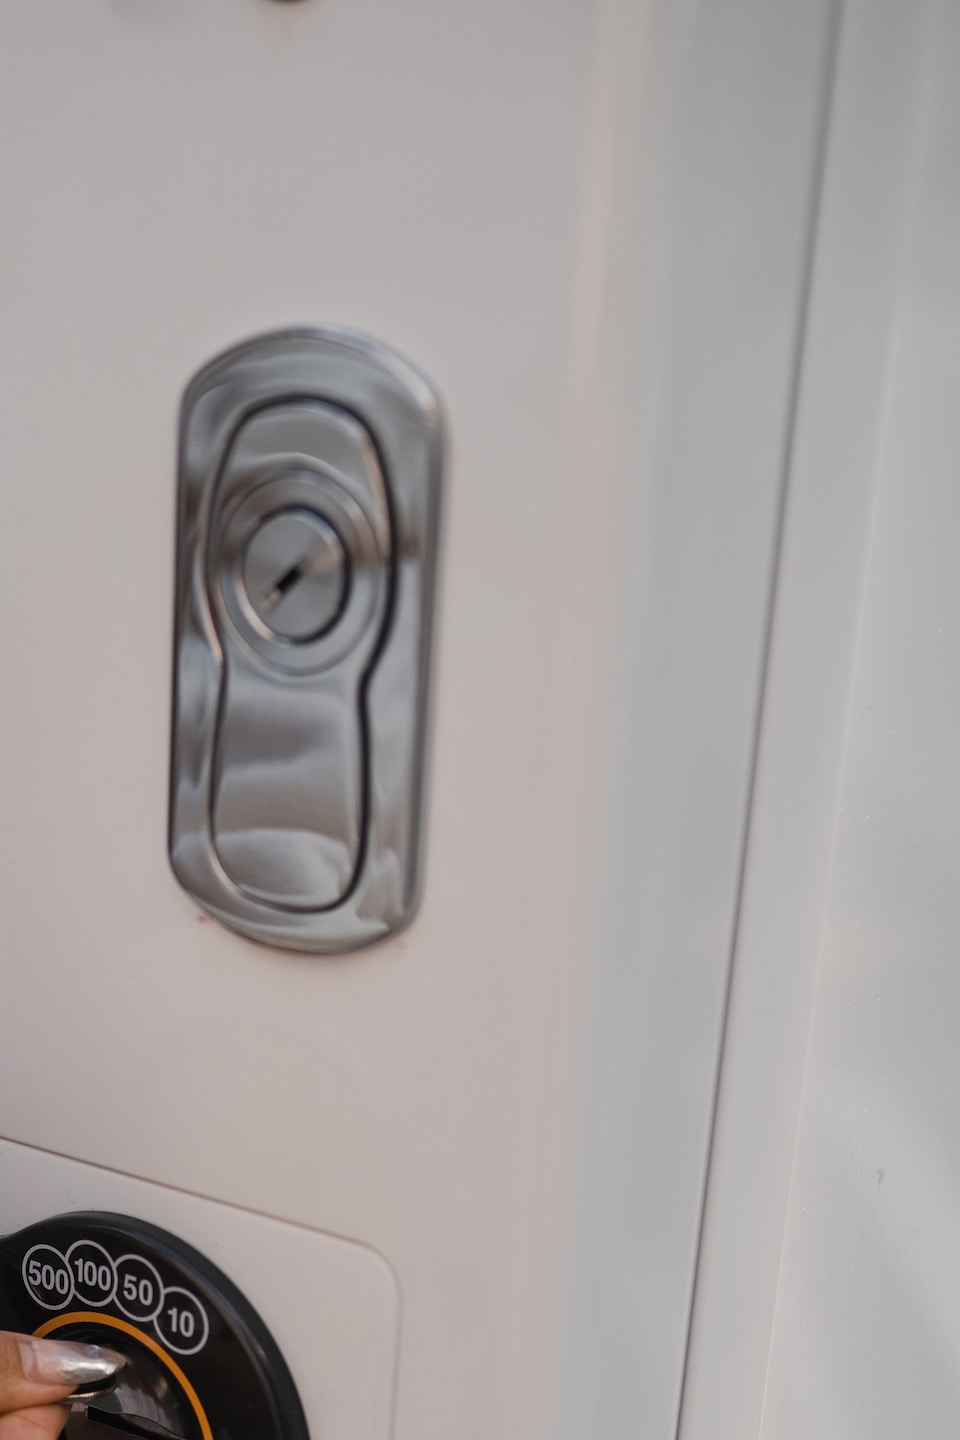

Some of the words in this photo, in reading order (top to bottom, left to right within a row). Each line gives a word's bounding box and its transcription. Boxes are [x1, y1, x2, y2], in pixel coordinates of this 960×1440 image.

[28, 1260, 69, 1295] 500
[74, 1258, 111, 1292] 100
[123, 1274, 153, 1306] 50
[167, 1307, 194, 1338] 10
